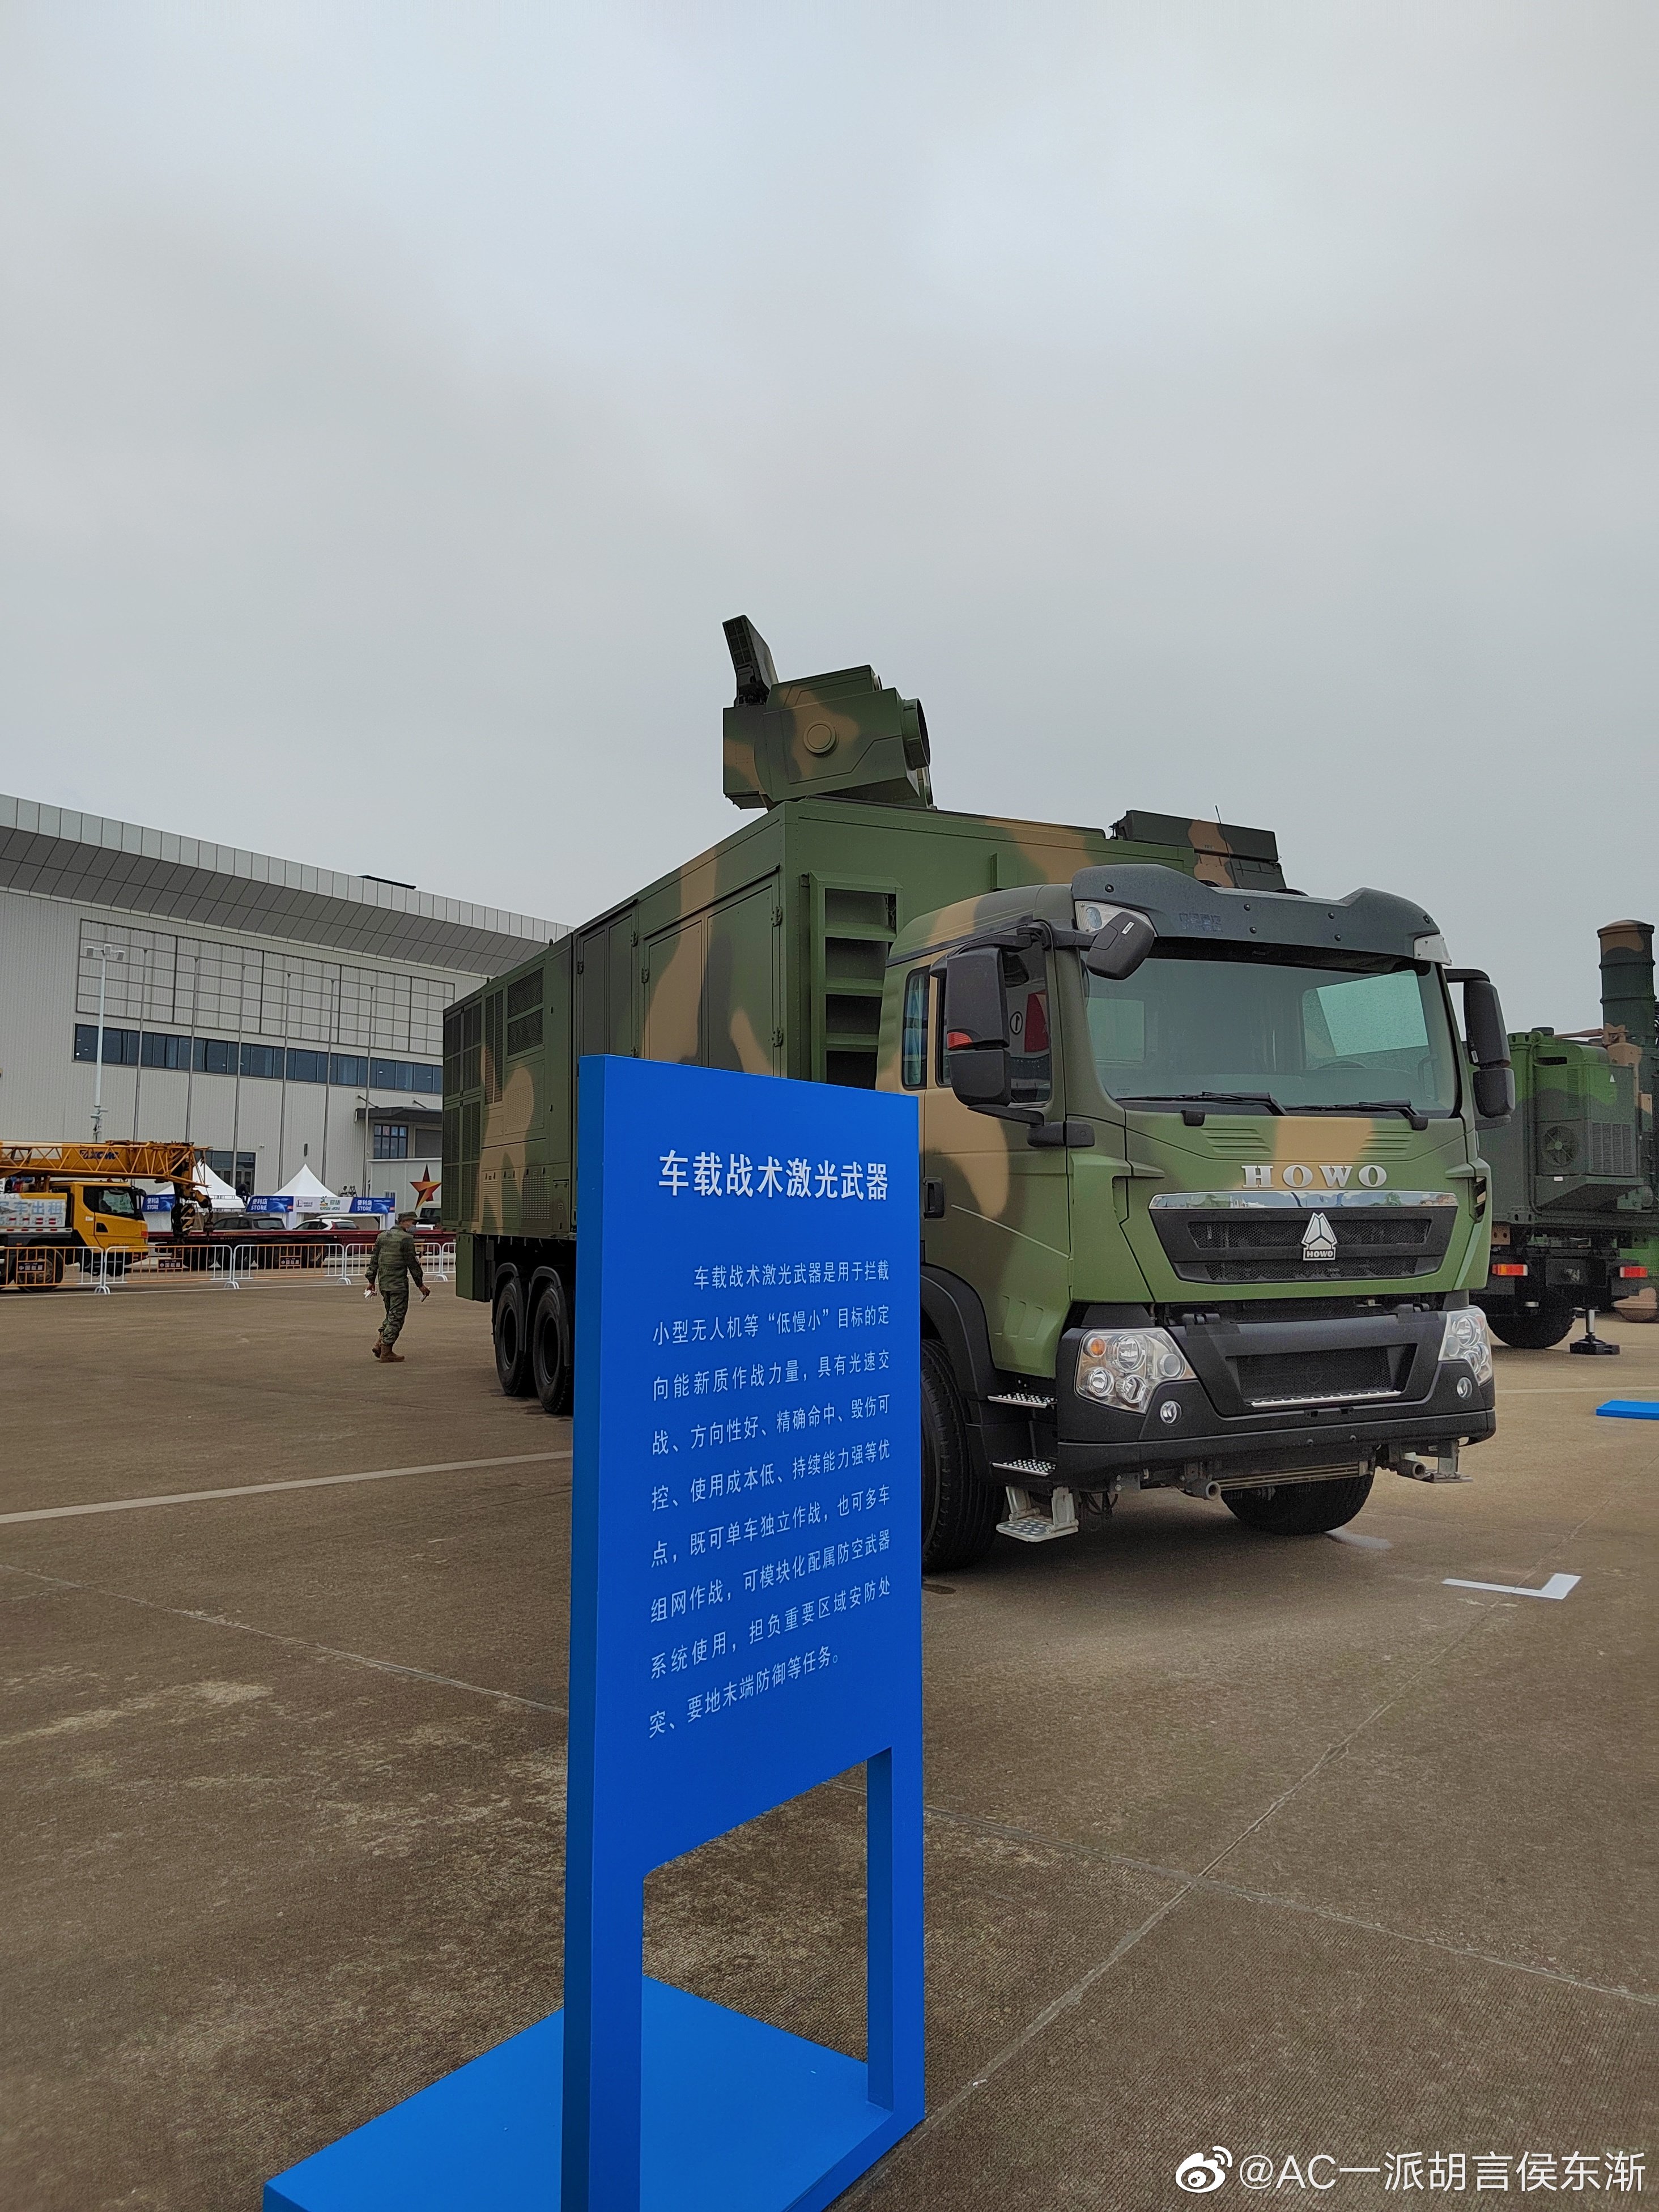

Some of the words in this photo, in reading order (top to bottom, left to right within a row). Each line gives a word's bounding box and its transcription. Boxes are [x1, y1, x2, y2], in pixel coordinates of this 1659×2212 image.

[658, 1149, 888, 1201] 车载战术激光武器
[1241, 1164, 1387, 1188] HOWO
[694, 1260, 889, 1290] 车载战术激光武器是用于拦截
[653, 1349, 889, 1401] 向能新质作战力量，具有光速交
[652, 1394, 890, 1455] 战、方向性好、精确命中、毁伤可
[652, 1439, 890, 1512] 控、使用成本低、持续能力强等优
[650, 1529, 890, 1623] 组网作战，可模块化配属防空武器
[651, 1576, 890, 1679] 系统使用，担负重要区域安防处
[649, 1645, 839, 1738] 突、要地末端防御等任务。
